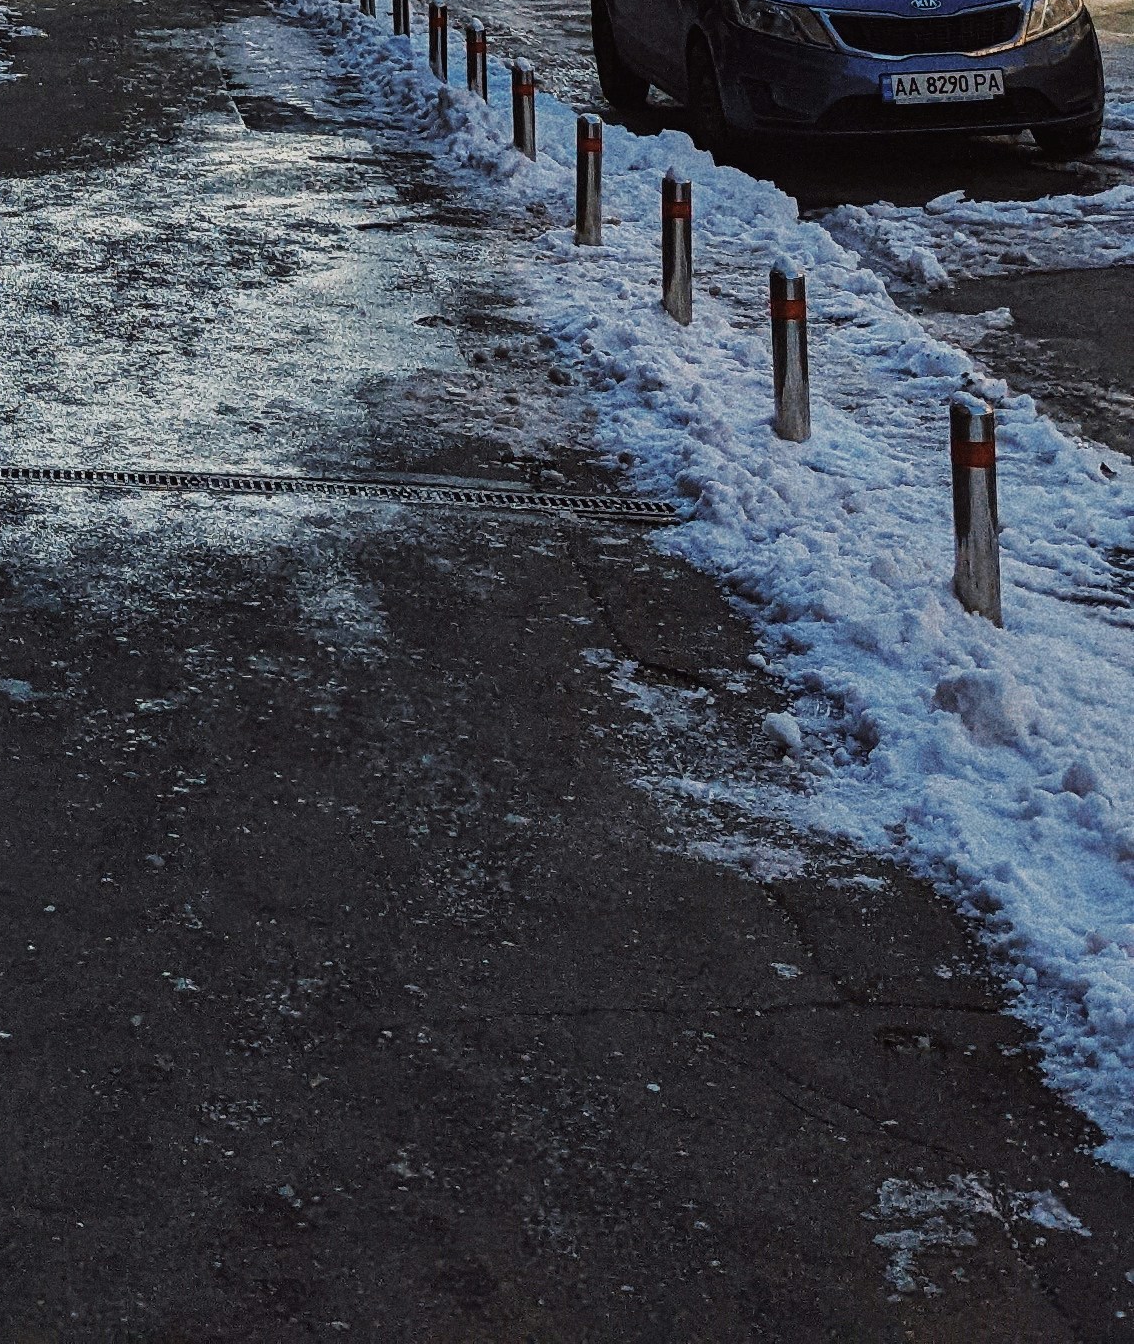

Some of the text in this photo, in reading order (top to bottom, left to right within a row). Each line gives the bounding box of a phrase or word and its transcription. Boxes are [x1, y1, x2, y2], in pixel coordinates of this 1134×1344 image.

[896, 73, 1000, 96] AA 8290 PA
